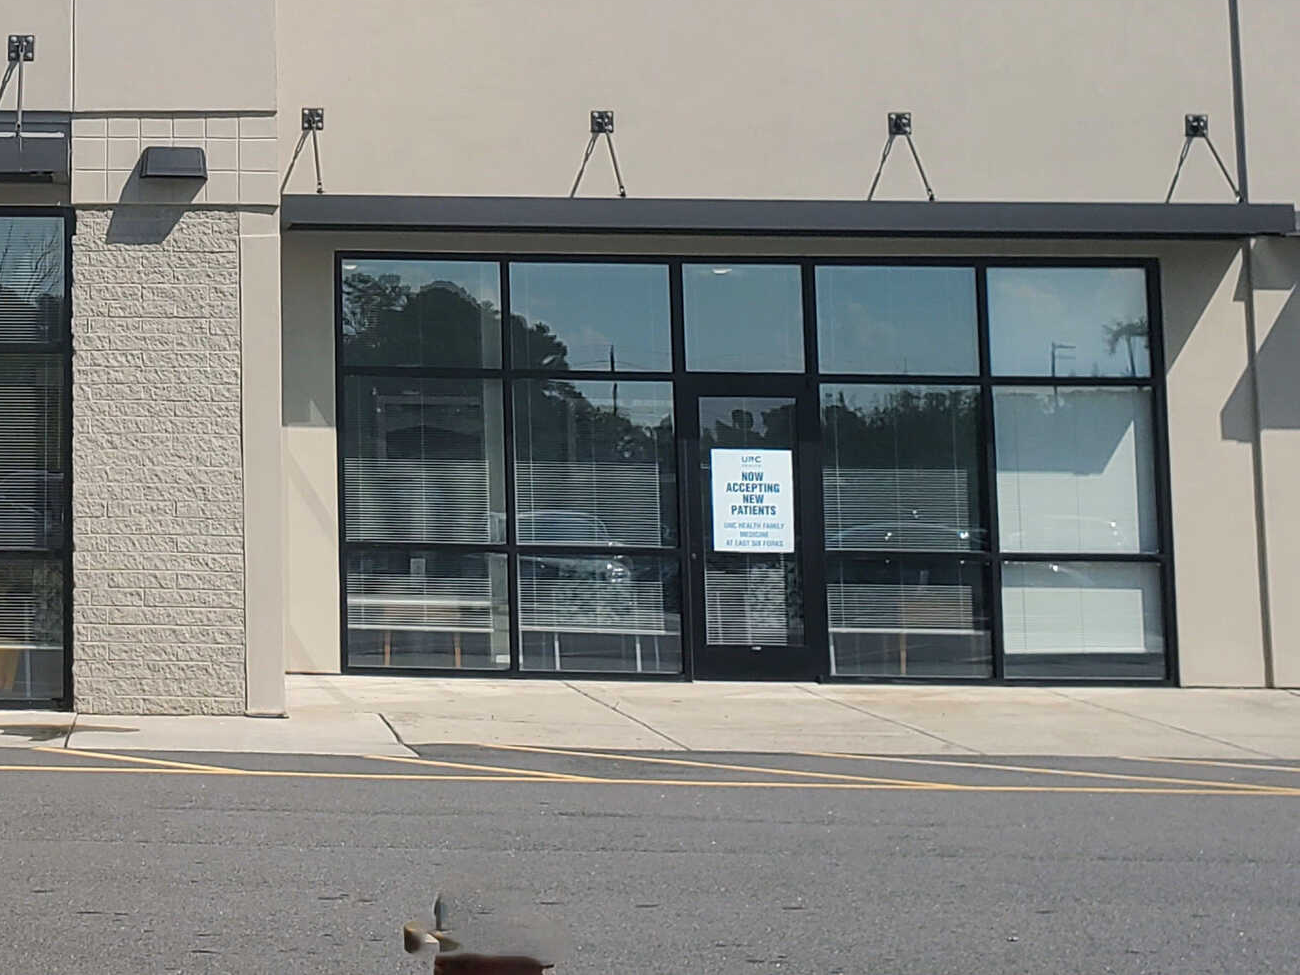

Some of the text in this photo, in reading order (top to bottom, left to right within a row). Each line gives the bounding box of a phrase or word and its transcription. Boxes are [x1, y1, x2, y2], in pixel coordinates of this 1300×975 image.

[741, 472, 764, 482] NOW
[726, 483, 781, 494] ACCEPTING
[742, 494, 765, 505] NEW
[731, 505, 777, 516] PATIENTS
